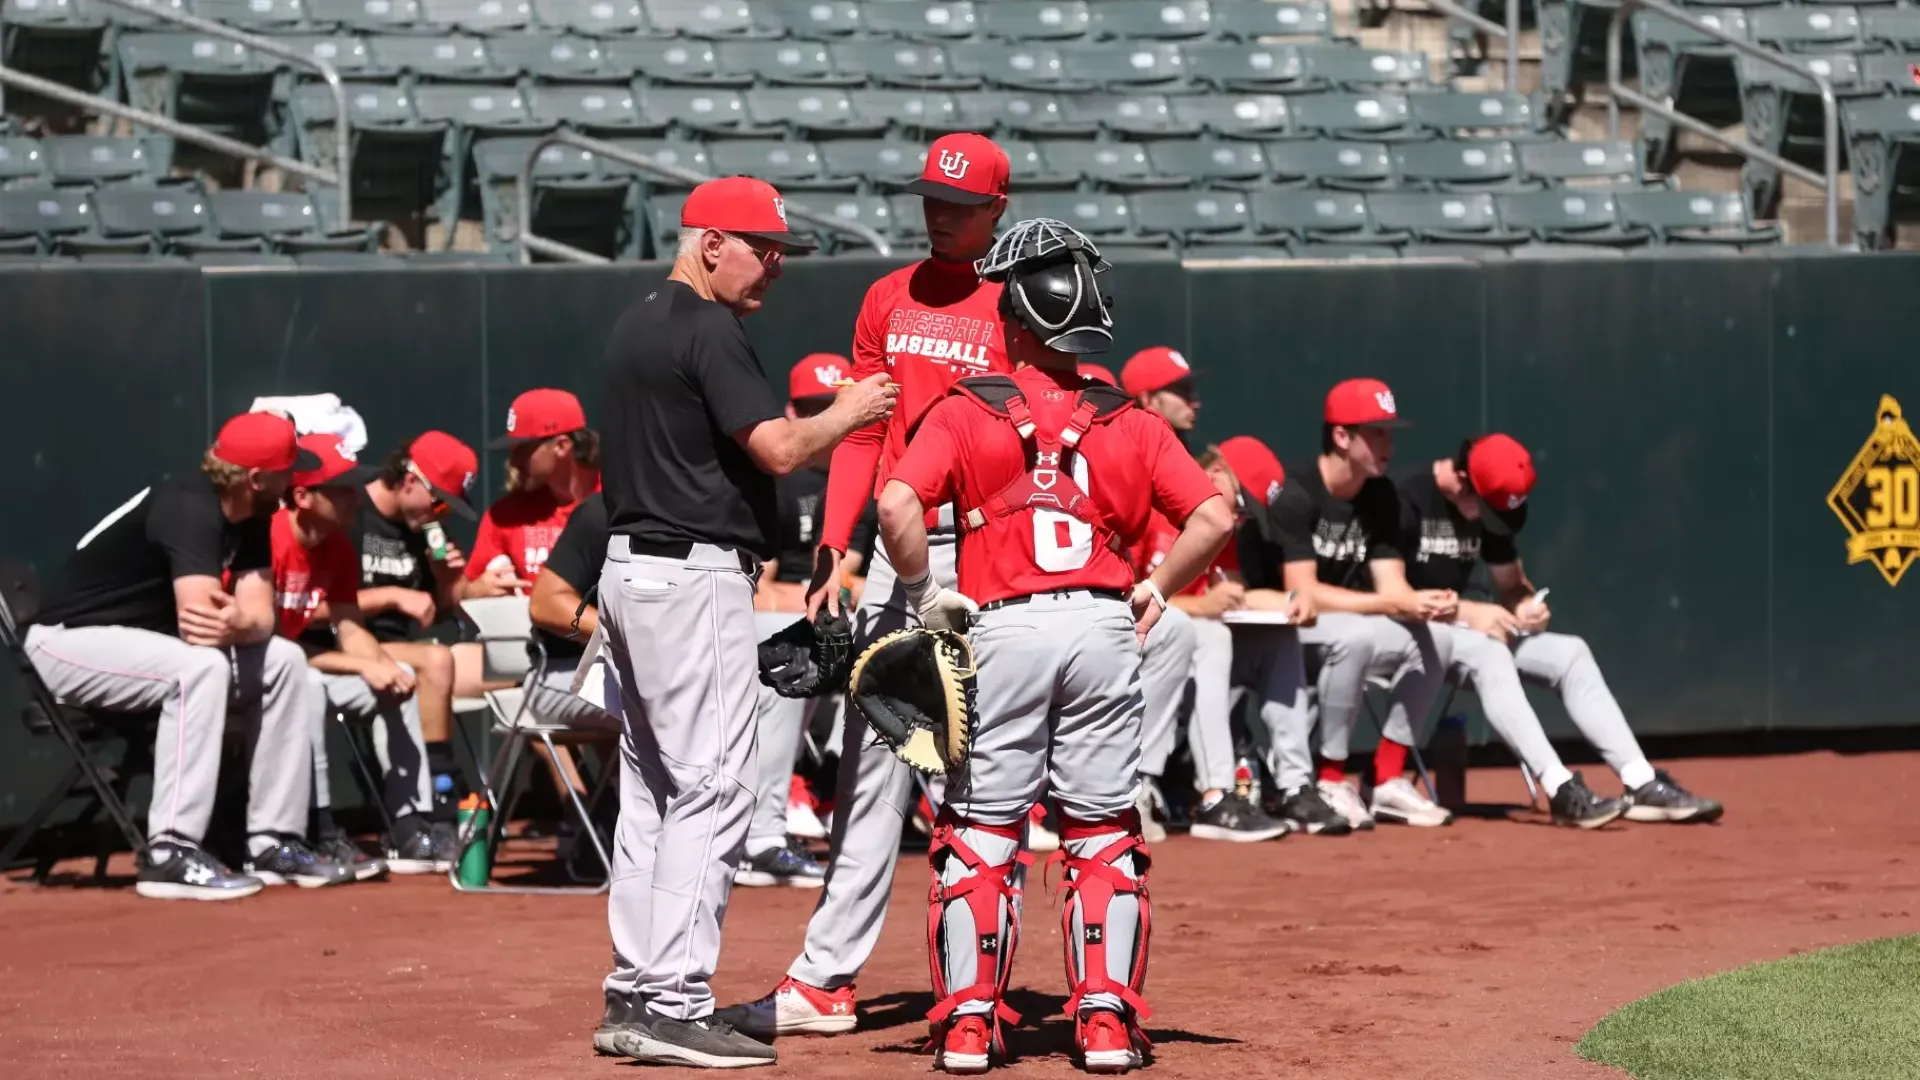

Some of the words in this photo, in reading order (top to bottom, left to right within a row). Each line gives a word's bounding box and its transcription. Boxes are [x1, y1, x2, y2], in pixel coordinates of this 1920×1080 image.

[886, 333, 990, 367] BASEBALL
[950, 366, 986, 377] UTA
[1865, 465, 1919, 529] 30
